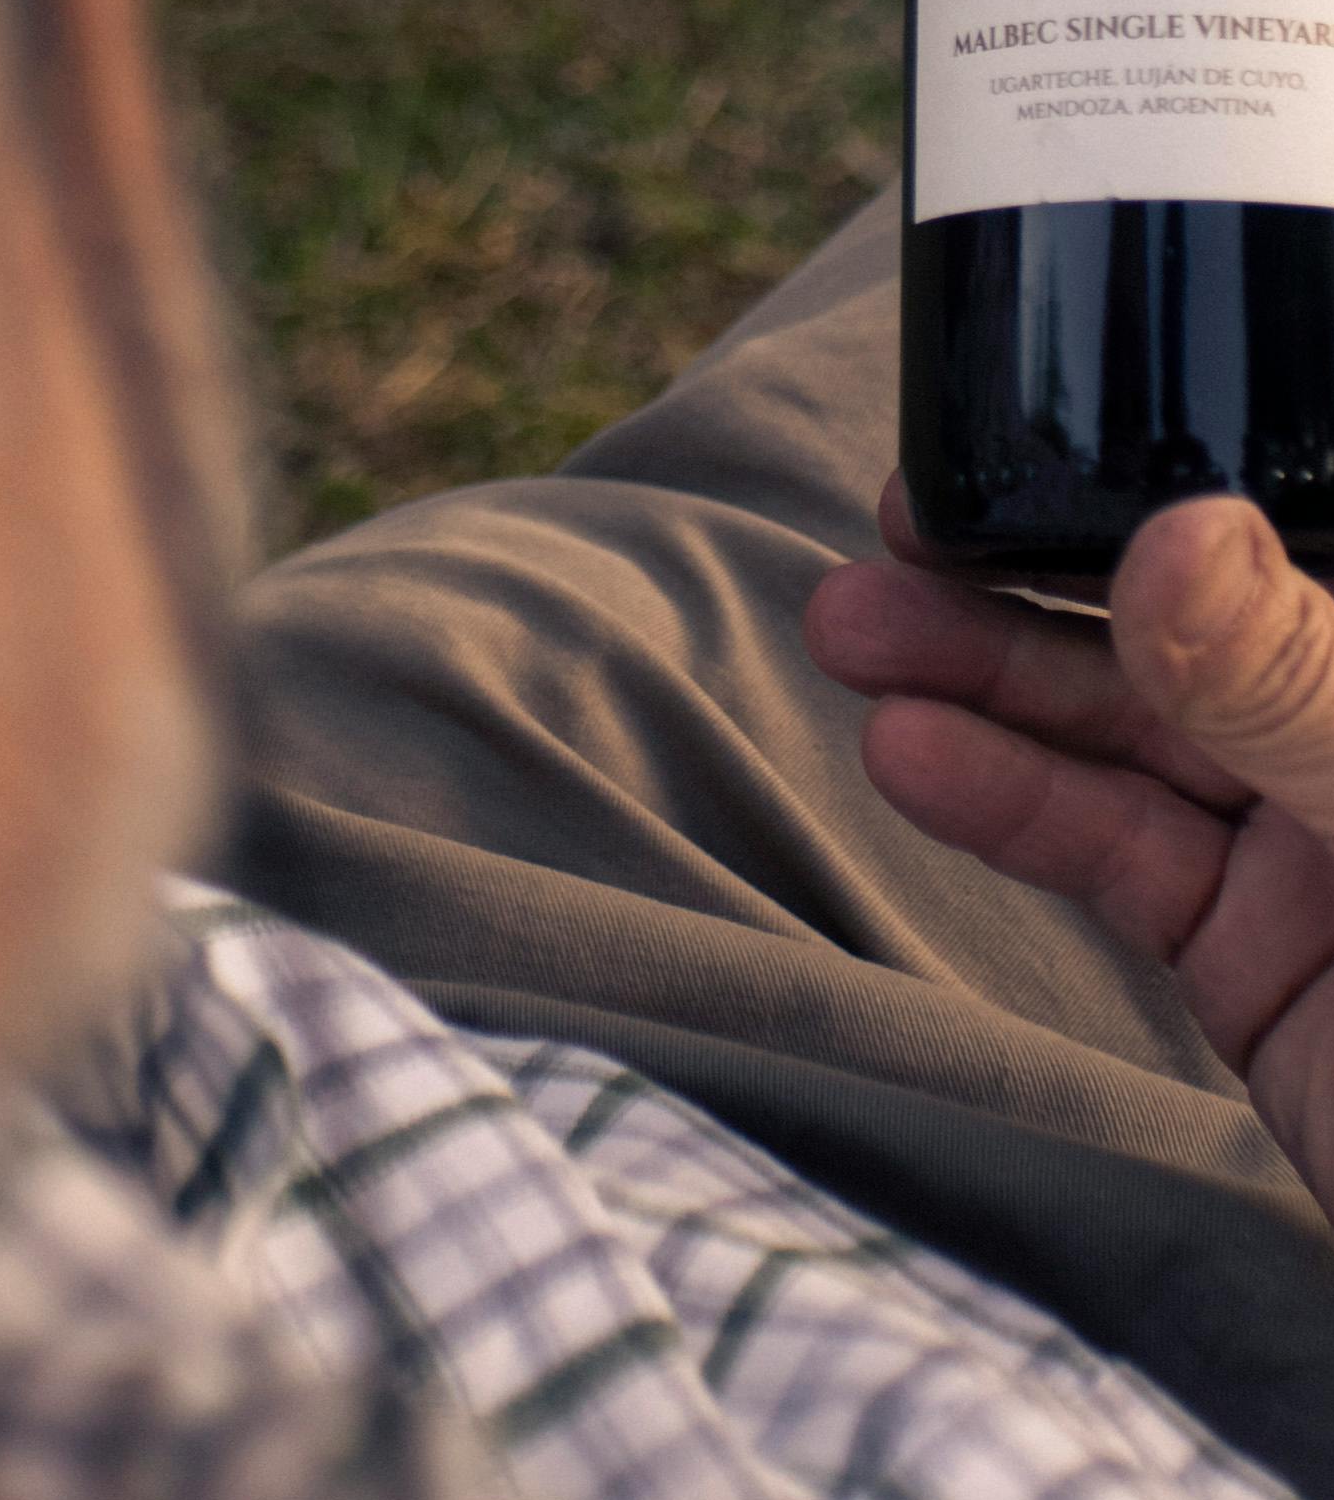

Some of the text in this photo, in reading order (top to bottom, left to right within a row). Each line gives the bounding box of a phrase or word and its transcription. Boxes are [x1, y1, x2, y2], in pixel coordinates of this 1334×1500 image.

[953, 19, 1059, 58] MALBEC
[1065, 14, 1185, 43] SINGLE
[1125, 64, 1197, 89] LUJÁN
[1203, 68, 1234, 86] DE
[1139, 97, 1276, 118] ARGENTINA
